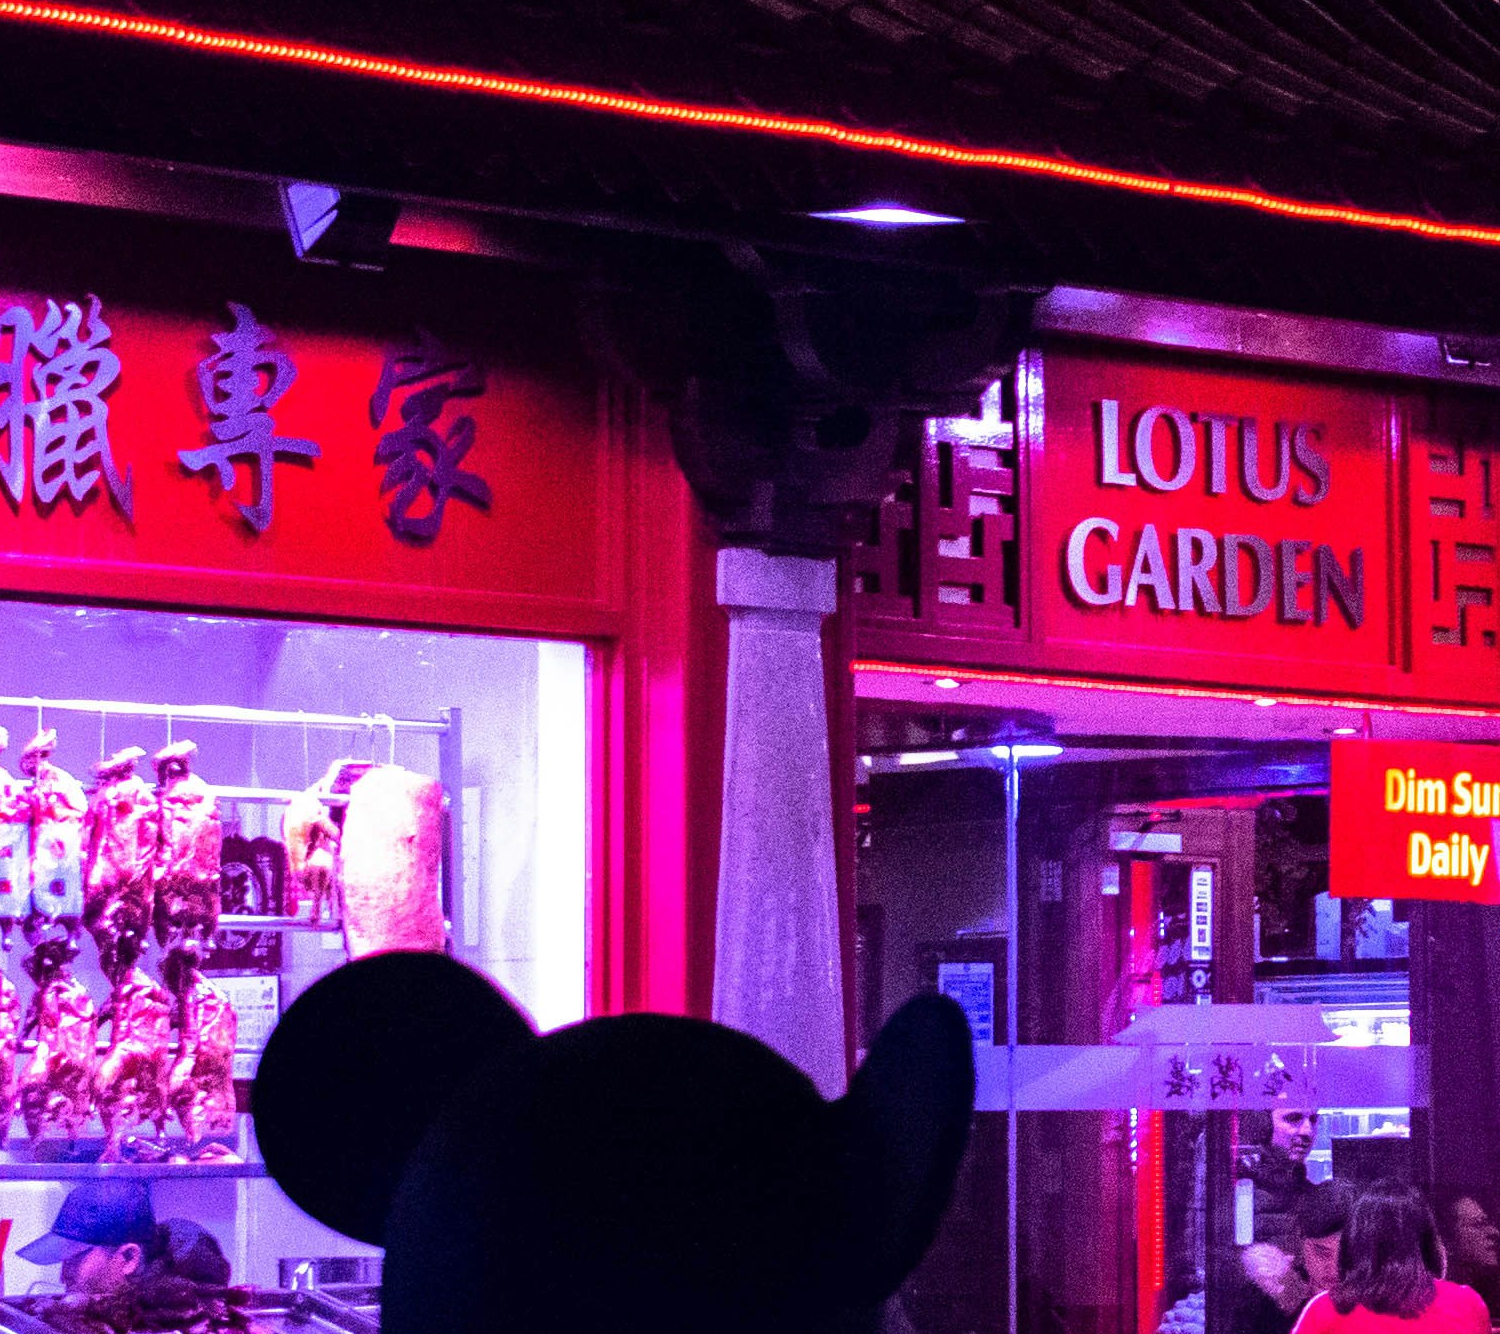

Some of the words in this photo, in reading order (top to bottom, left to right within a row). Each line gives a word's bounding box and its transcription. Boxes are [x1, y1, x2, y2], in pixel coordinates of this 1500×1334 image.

[1098, 398, 1331, 505] LOTUS
[1066, 518, 1364, 628] GARDEN
[1385, 768, 1447, 816] Dim
[1408, 832, 1490, 886] Daily
